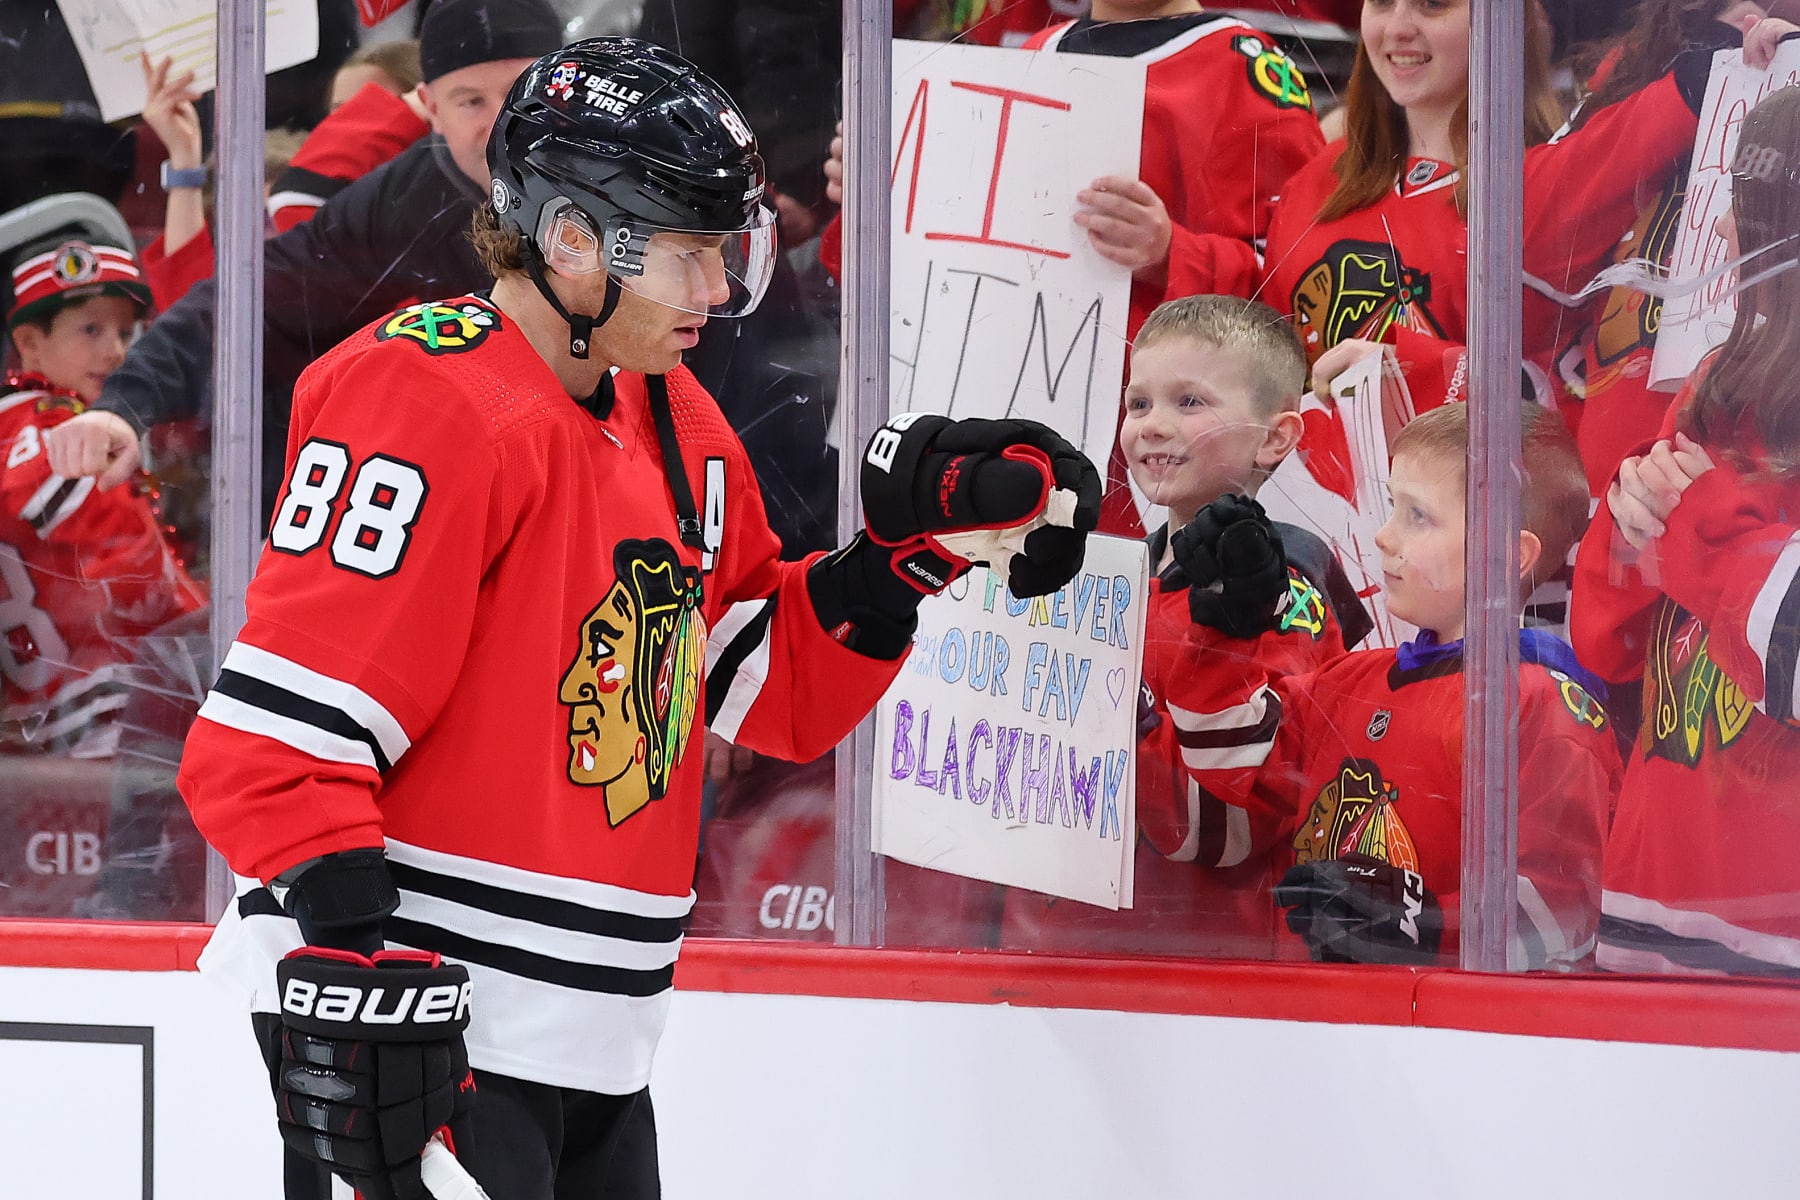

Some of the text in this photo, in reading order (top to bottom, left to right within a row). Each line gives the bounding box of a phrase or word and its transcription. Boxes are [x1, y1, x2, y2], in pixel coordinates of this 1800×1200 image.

[584, 74, 644, 104] BELLE
[585, 90, 629, 116] TIRE
[271, 439, 428, 578] 88
[939, 627, 1092, 728] OUR FAV
[889, 699, 1128, 842] BLACKHAWK
